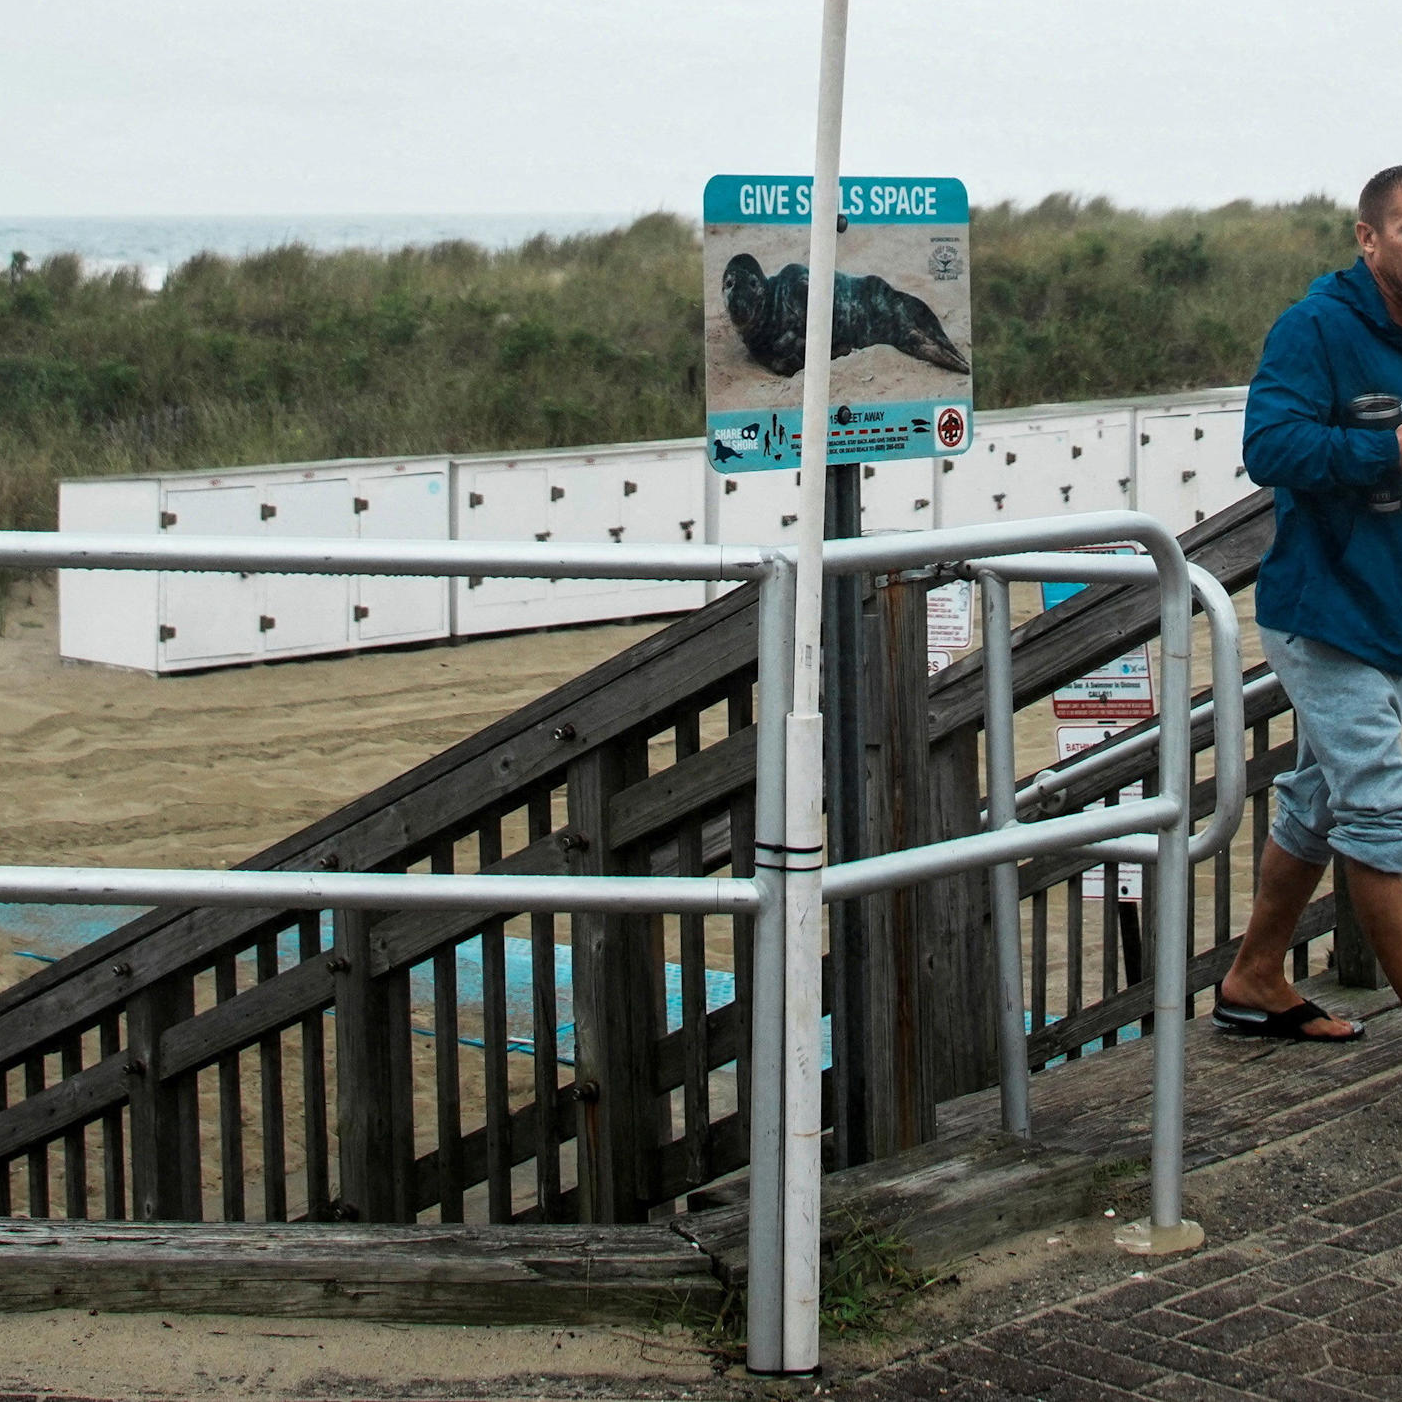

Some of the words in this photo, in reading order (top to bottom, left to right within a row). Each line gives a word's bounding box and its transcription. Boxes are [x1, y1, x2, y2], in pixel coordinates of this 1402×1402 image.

[740, 184, 789, 215] GIVE
[796, 185, 864, 215] SLS
[870, 186, 937, 215] SPACE
[864, 411, 885, 422] AWAY
[715, 428, 742, 440] SHARE
[732, 439, 758, 450] SHORE
